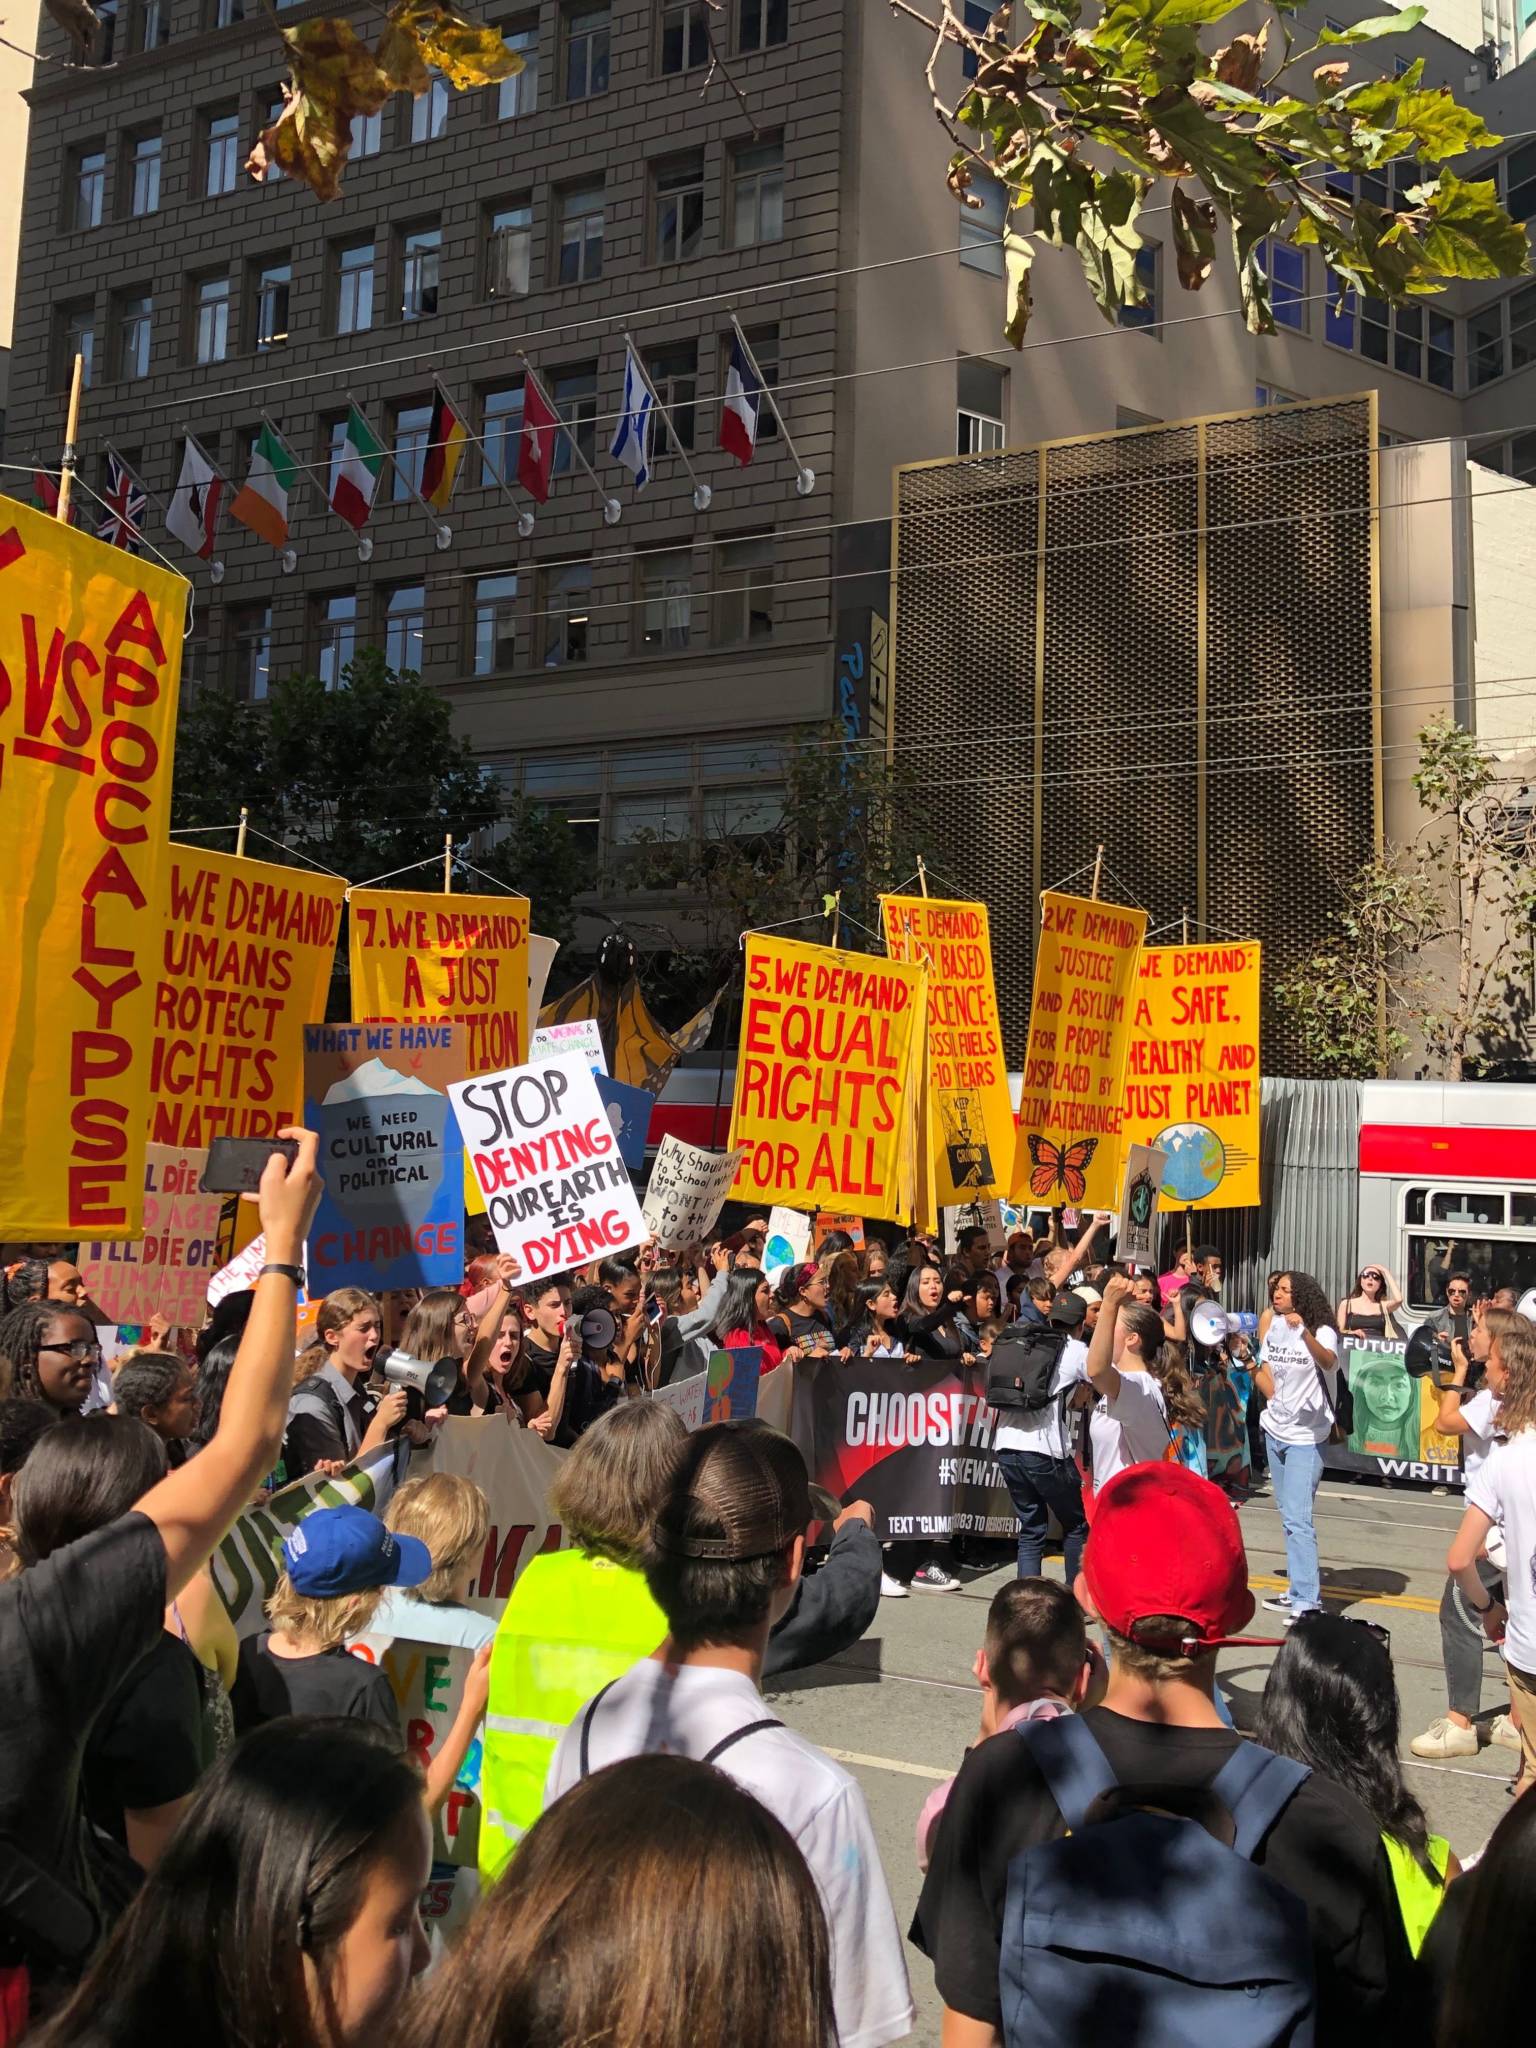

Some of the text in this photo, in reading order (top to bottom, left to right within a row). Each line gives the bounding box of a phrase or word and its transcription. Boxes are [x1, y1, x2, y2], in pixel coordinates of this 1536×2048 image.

[68, 589, 168, 1227] APOCALYPSE
[225, 877, 342, 948] DEMAND:
[926, 911, 984, 940] DEMAND:
[435, 912, 528, 950] DEMAND:
[1083, 911, 1139, 948] DEMAND:
[163, 929, 293, 992] UMANS
[940, 944, 986, 981] BASED
[1055, 946, 1115, 984] JUSTICE
[1173, 950, 1254, 977] DEMAND:
[403, 956, 500, 1008] A JUST
[813, 964, 915, 1014] DEMAND:
[153, 981, 285, 1042] ROTECT
[1036, 987, 1124, 1024] AND ASYLUM
[1134, 999, 1153, 1027] A
[304, 1026, 453, 1053] WHAT WE HAVE
[745, 998, 898, 1070] EQUAL
[929, 1031, 997, 1059] OSSIL FUELS
[1032, 1024, 1112, 1059] FOR PEOPLE
[149, 1036, 278, 1102] IGHTS
[1218, 1043, 1256, 1071] AND
[954, 1062, 995, 1088] YEARS
[1024, 1061, 1114, 1097] DISPLACED BY
[461, 1069, 569, 1147] STOP
[739, 1058, 903, 1133] RIGHTS
[1122, 1079, 1252, 1120] JUST PLANET
[346, 1111, 418, 1132] WE NEED
[330, 1130, 438, 1159] CULTURAL
[366, 1153, 398, 1169] and
[473, 1117, 613, 1195] DENYING
[661, 1136, 686, 1170] Why
[340, 1164, 429, 1193] POLITICAL
[656, 1157, 668, 1174] to
[674, 1168, 711, 1189] School
[656, 1173, 676, 1187] you
[733, 1132, 885, 1197] FOR ALL
[488, 1156, 629, 1230] OUR EARTH
[171, 1203, 220, 1232] AGE
[547, 1202, 585, 1229] IS
[661, 1205, 678, 1222] to
[186, 1239, 215, 1267] OF
[314, 1220, 457, 1269] CHANGE
[522, 1209, 630, 1275] DYING
[81, 1263, 210, 1297] CLIMATE
[86, 1290, 200, 1328] HANGE
[1267, 1354, 1309, 1366] OCALYPSE
[1342, 1336, 1406, 1354] FUTUR
[1376, 1457, 1466, 1484] WRIT
[888, 1516, 914, 1534] TEXT
[974, 1515, 986, 1532] TO
